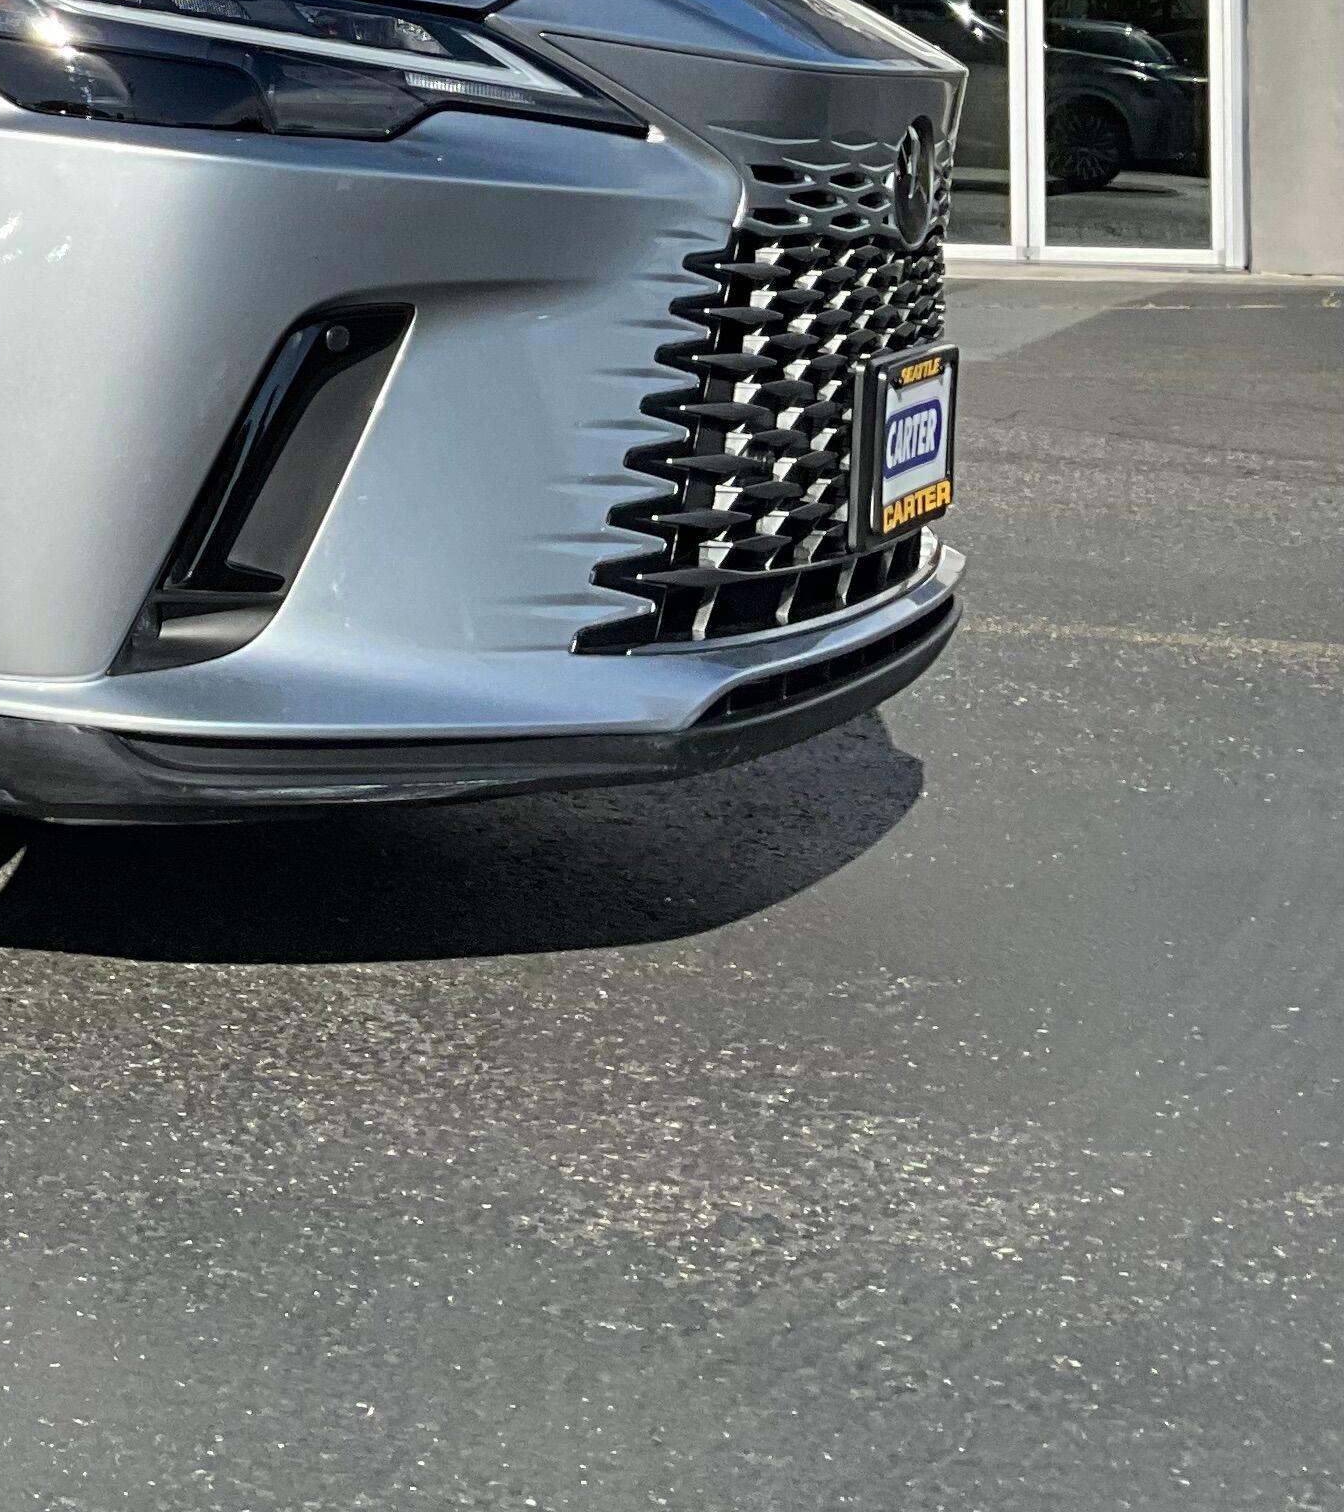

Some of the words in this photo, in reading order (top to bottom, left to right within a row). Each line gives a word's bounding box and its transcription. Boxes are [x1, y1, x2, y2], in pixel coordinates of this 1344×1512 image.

[901, 357, 942, 385] SEATTLE
[886, 408, 938, 469] CARTER
[883, 480, 951, 535] CARTER
